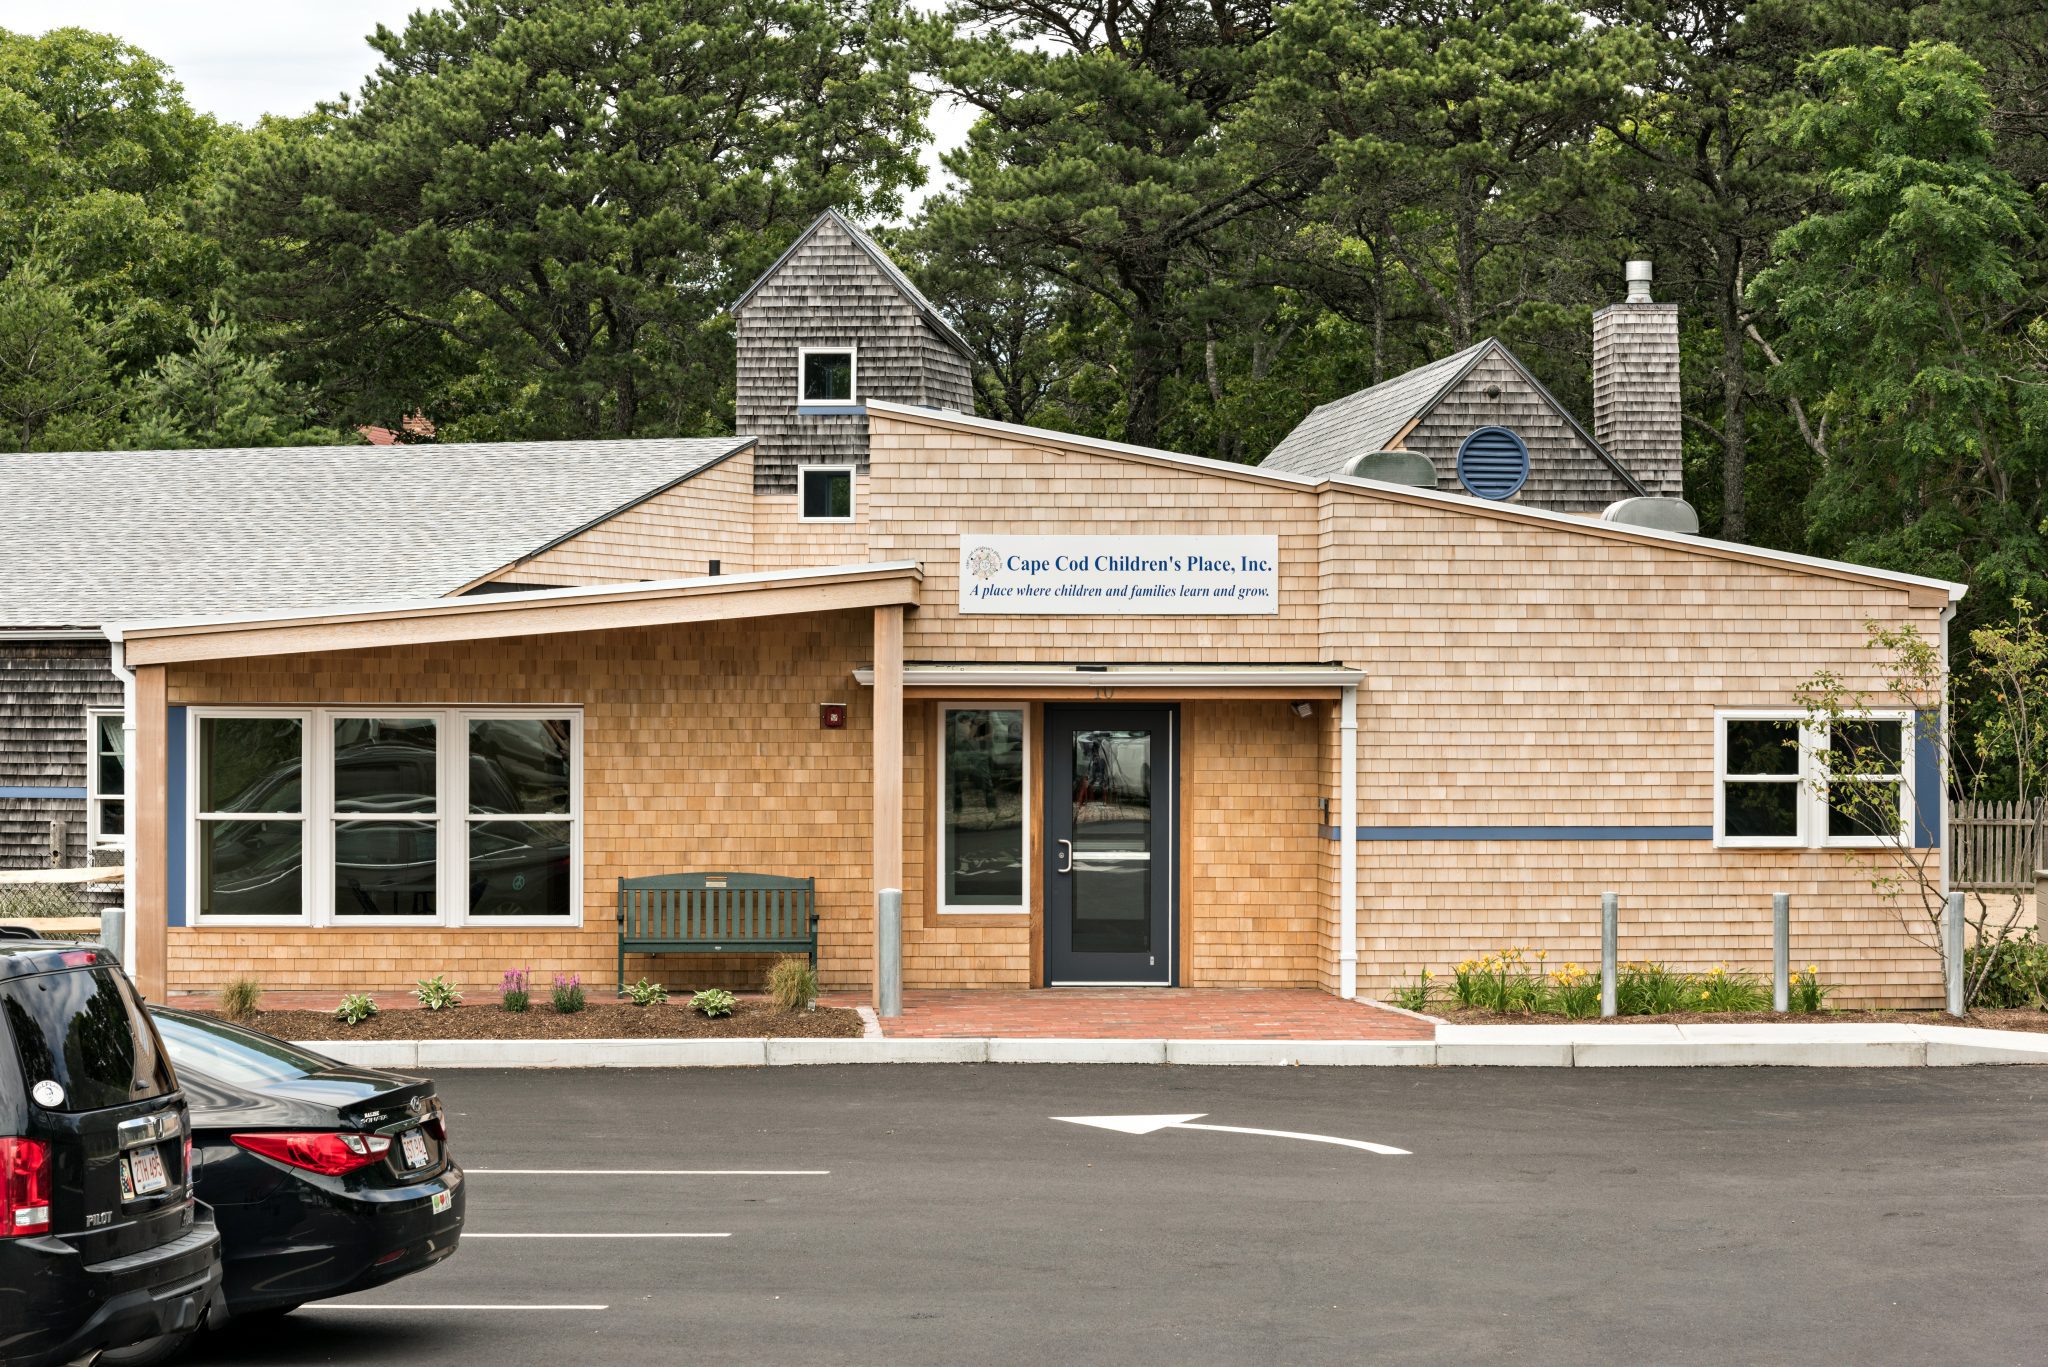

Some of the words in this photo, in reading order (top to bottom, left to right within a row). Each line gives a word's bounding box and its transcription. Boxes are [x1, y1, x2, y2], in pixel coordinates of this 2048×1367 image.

[1007, 555, 1050, 576] Cape
[1055, 555, 1089, 572] Cod
[1094, 555, 1182, 572] Children's
[1187, 555, 1236, 574] Place,
[1241, 555, 1272, 572] Inc.
[969, 583, 979, 596] A
[981, 583, 1014, 600] place
[1016, 583, 1052, 597] where
[1054, 584, 1102, 597] children
[1105, 584, 1128, 597] and
[1128, 584, 1177, 600] families
[1179, 584, 1210, 597] learn
[1213, 584, 1236, 597] and
[1237, 588, 1270, 600] grow.
[134, 1159, 150, 1183] 2TH
[149, 1156, 163, 1179] 495
[86, 1211, 113, 1228] PILOT
